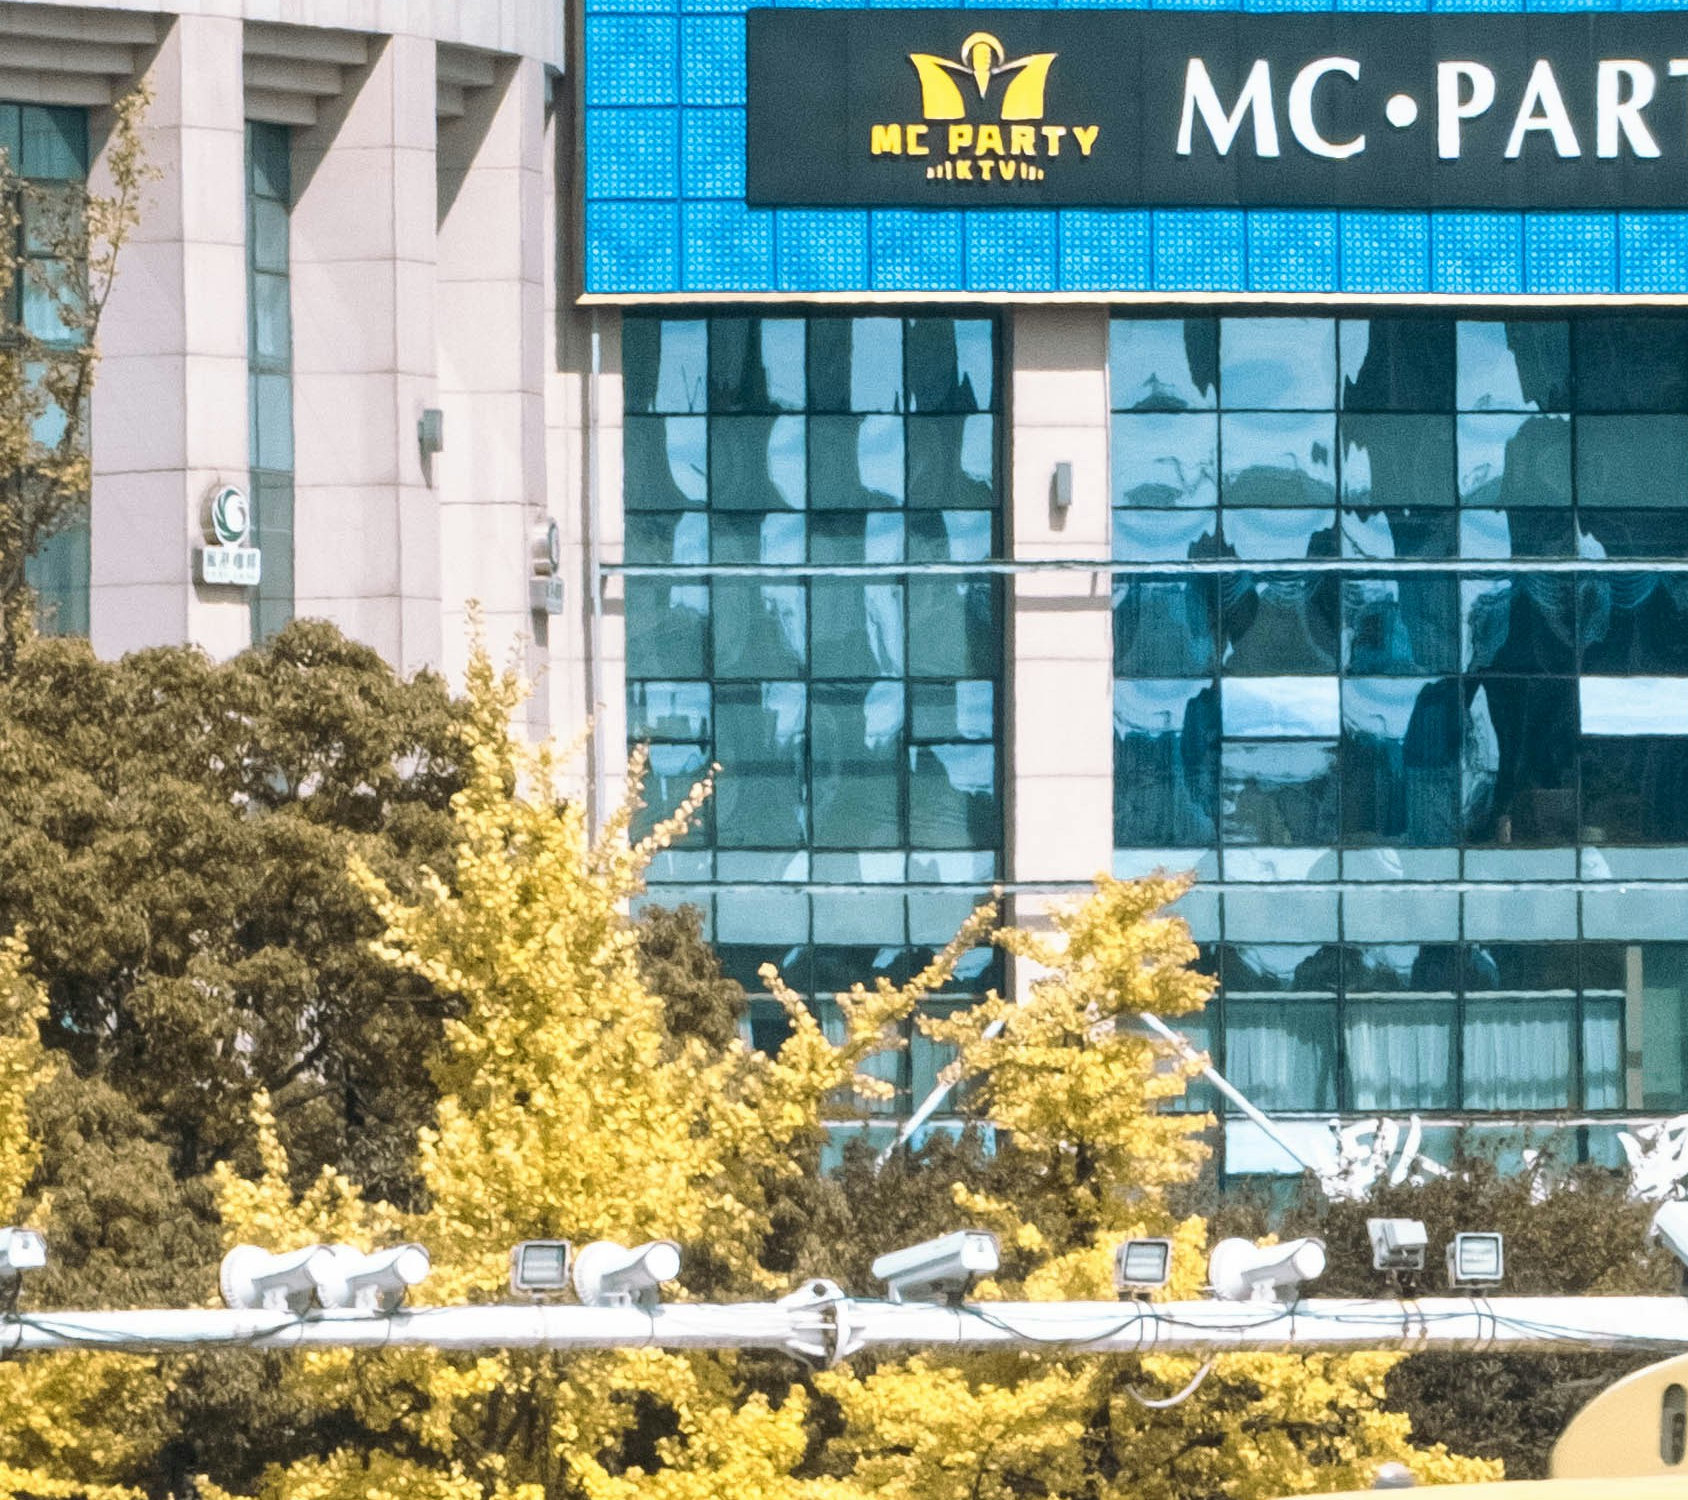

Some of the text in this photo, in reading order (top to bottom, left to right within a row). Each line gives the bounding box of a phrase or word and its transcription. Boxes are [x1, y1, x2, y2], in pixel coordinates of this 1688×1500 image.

[871, 123, 1100, 157] MC PARTY
[955, 159, 1017, 181] KTV
